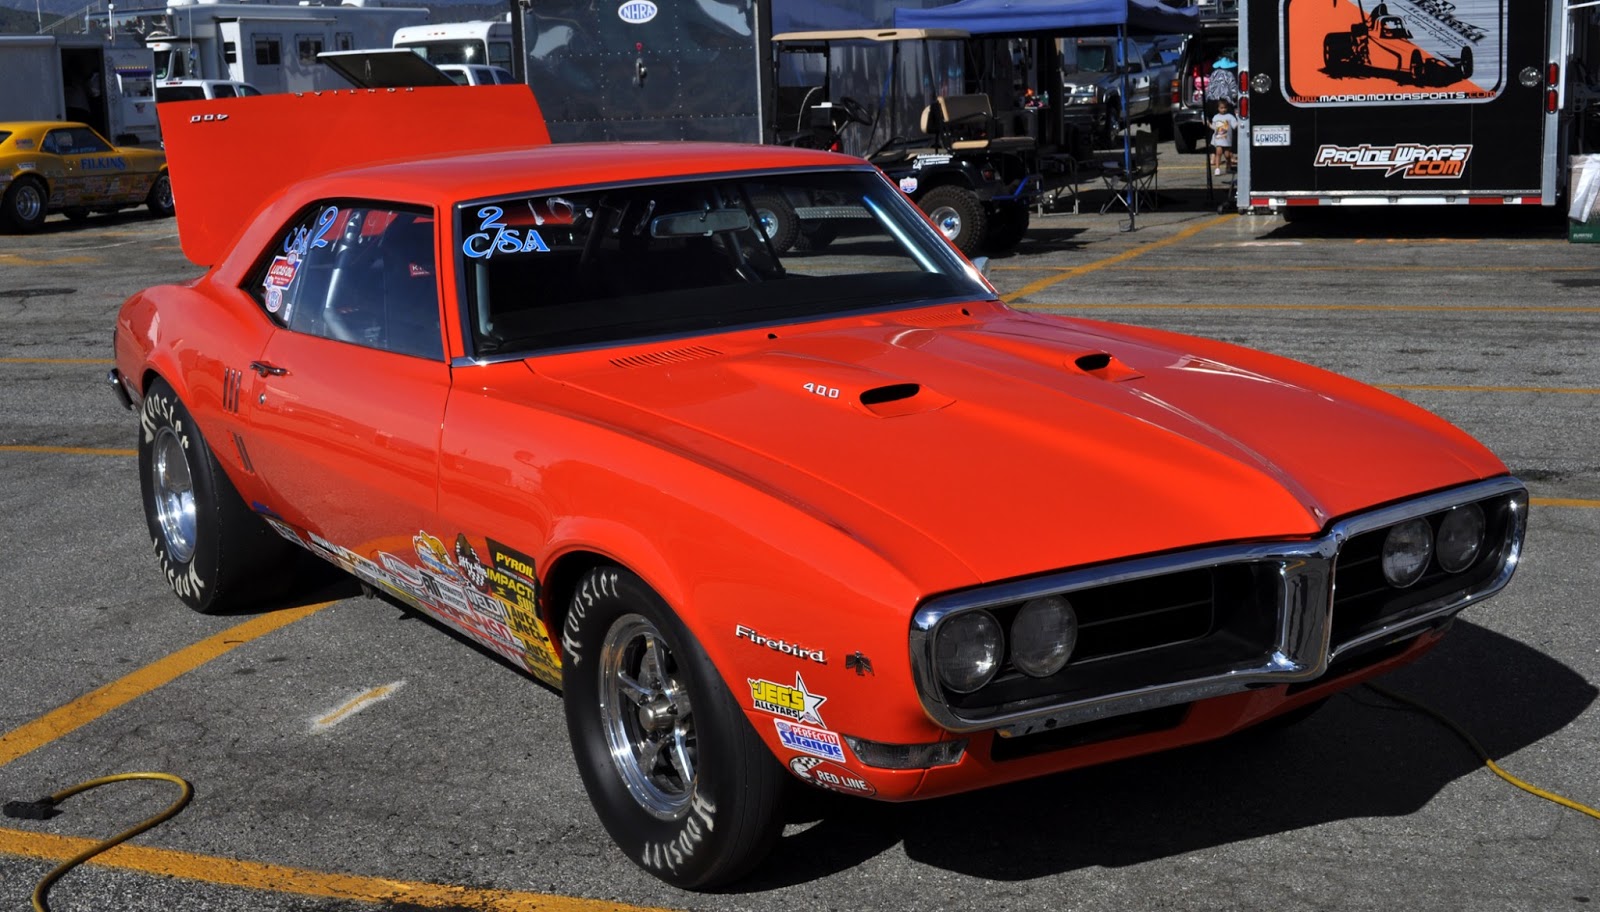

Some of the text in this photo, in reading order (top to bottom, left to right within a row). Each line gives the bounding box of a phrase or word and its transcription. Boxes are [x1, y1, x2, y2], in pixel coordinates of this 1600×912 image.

[623, 4, 655, 19] NHRA
[80, 156, 126, 170] FILKINS
[310, 205, 339, 249] 2
[477, 201, 507, 231] 2
[462, 227, 551, 259] C/SA
[803, 382, 839, 399] 400
[495, 552, 534, 580] PYROIL
[562, 570, 619, 666] Hoosier
[735, 624, 828, 664] Firebird
[753, 680, 805, 712] JEG'S
[754, 700, 799, 719] ALLSTARS
[779, 730, 842, 757] Strange
[791, 724, 838, 746] PERFECTLY
[816, 770, 840, 785] RED
[841, 777, 868, 791] LINE
